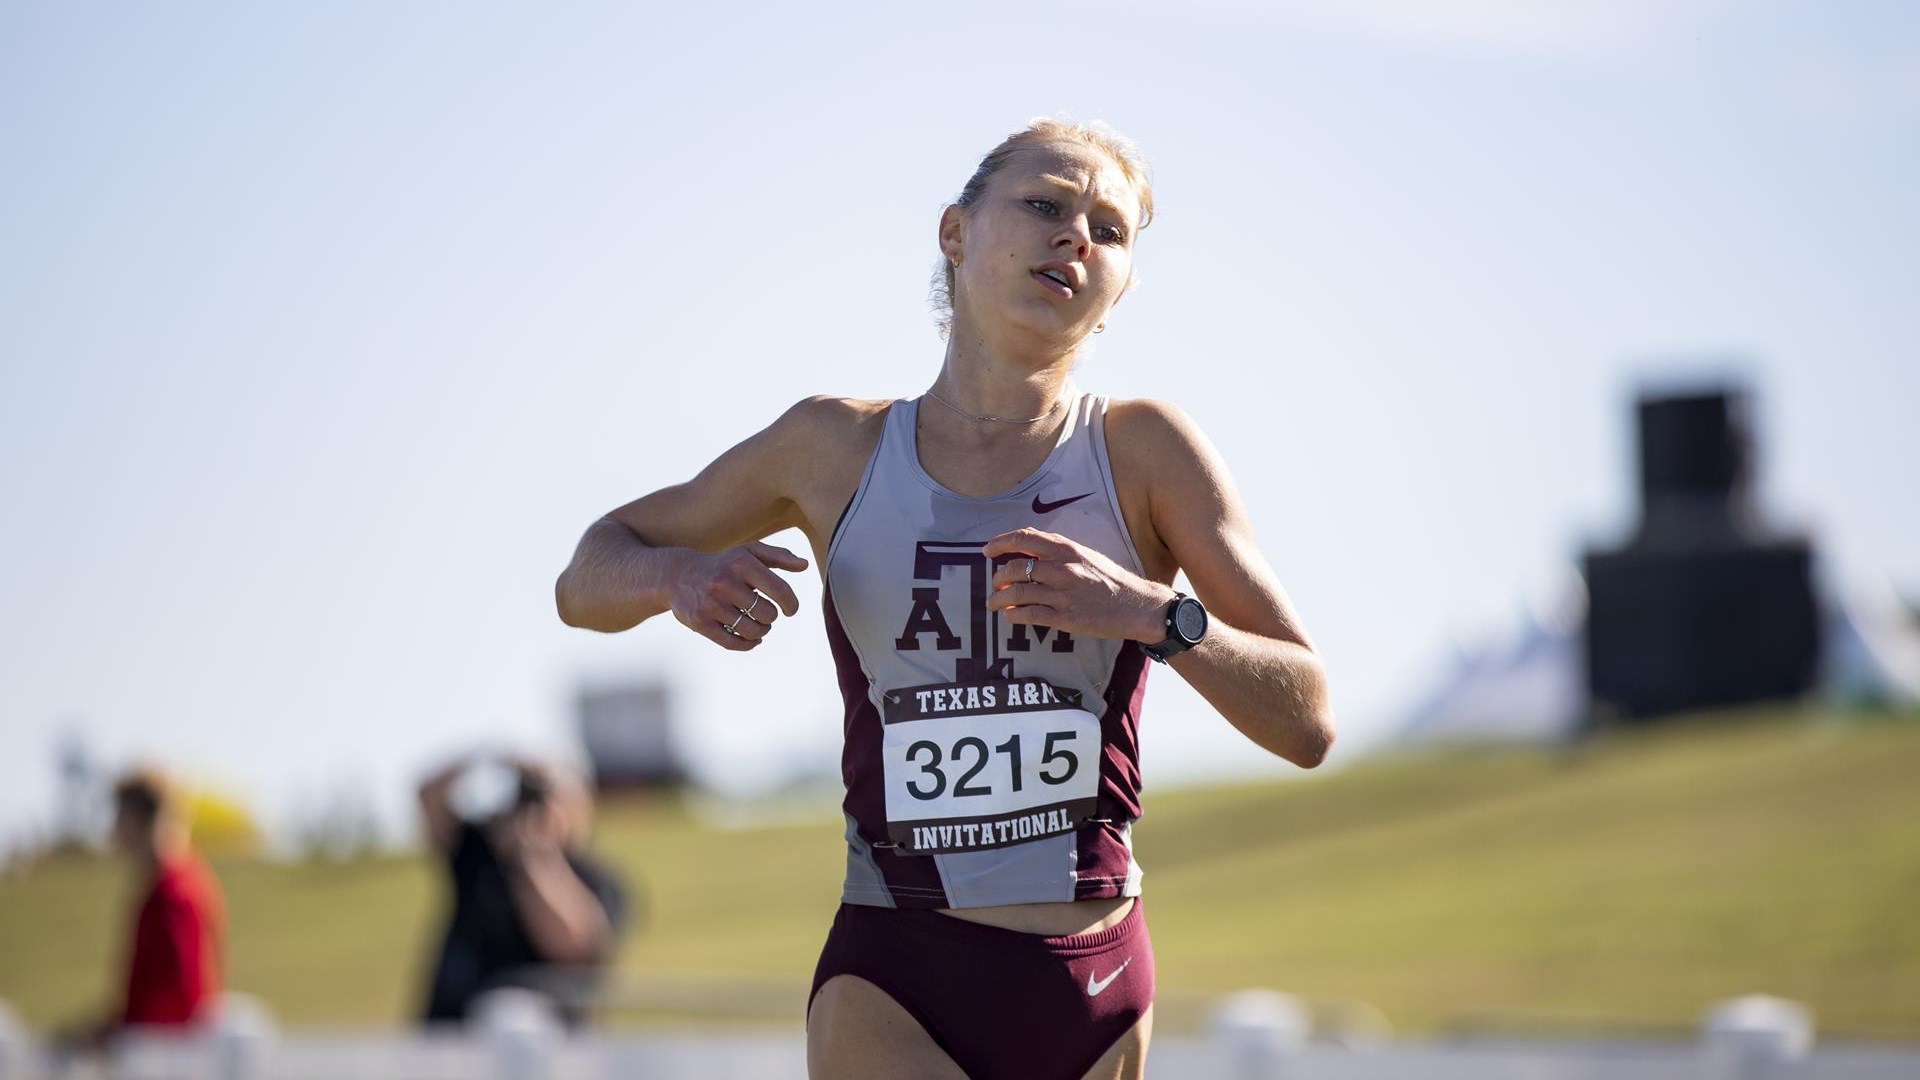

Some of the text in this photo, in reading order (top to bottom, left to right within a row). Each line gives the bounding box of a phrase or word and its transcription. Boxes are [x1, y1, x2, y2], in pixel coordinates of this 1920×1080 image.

[916, 685, 996, 713] TEXAS
[905, 730, 1079, 801] 3215
[912, 808, 1073, 850] INVITATIONAL
